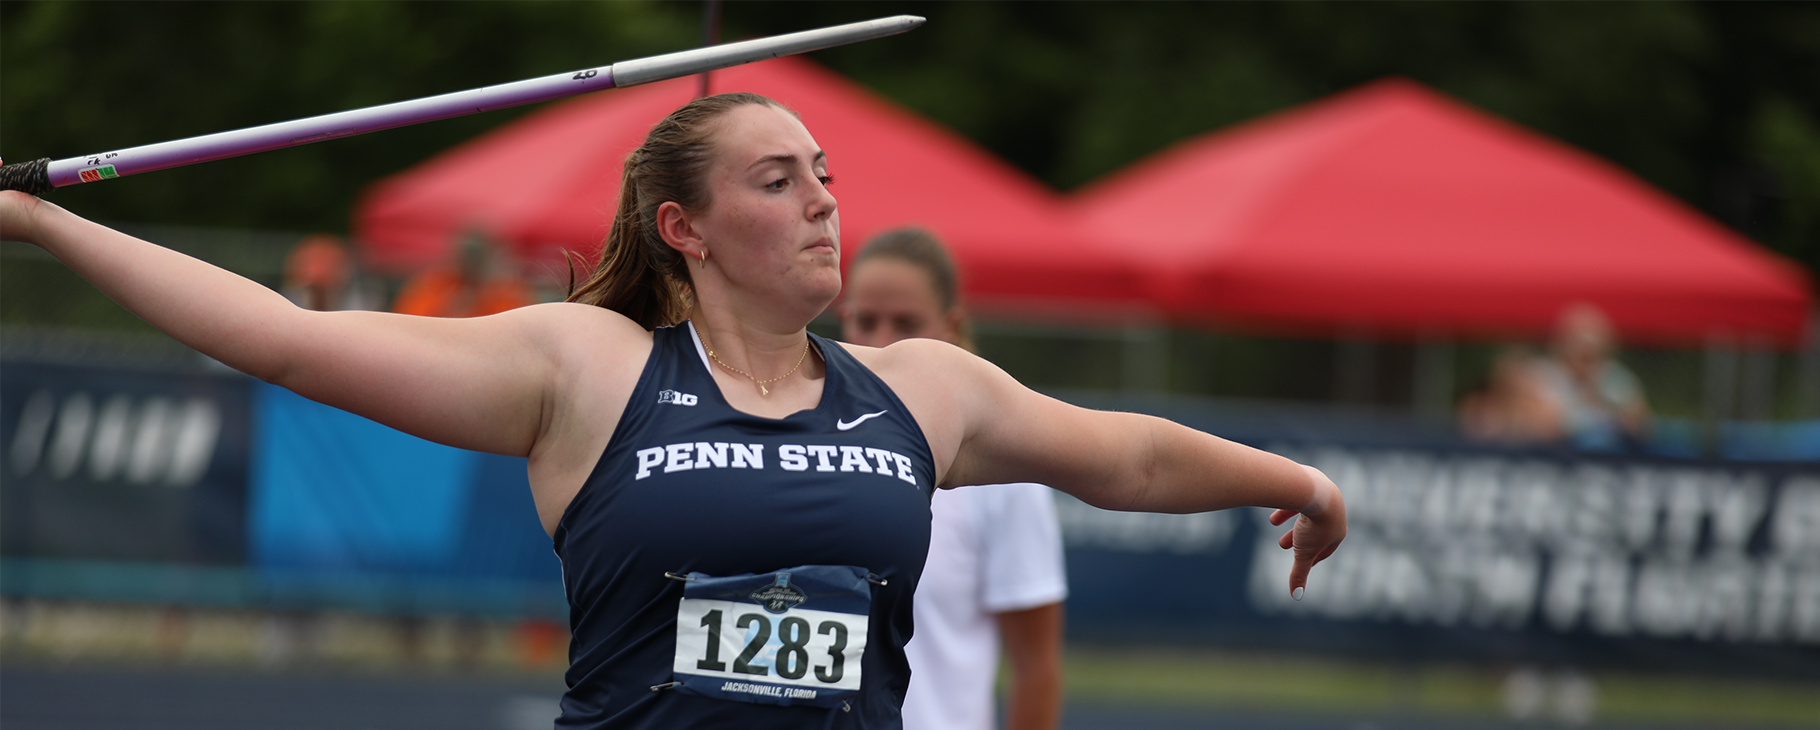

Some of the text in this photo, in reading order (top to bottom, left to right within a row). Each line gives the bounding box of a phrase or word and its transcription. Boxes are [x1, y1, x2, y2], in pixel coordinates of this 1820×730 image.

[635, 441, 917, 486] PENN STATE
[697, 609, 848, 683] 1283
[721, 681, 817, 699] JACKSONVILLE, FLORIDA
